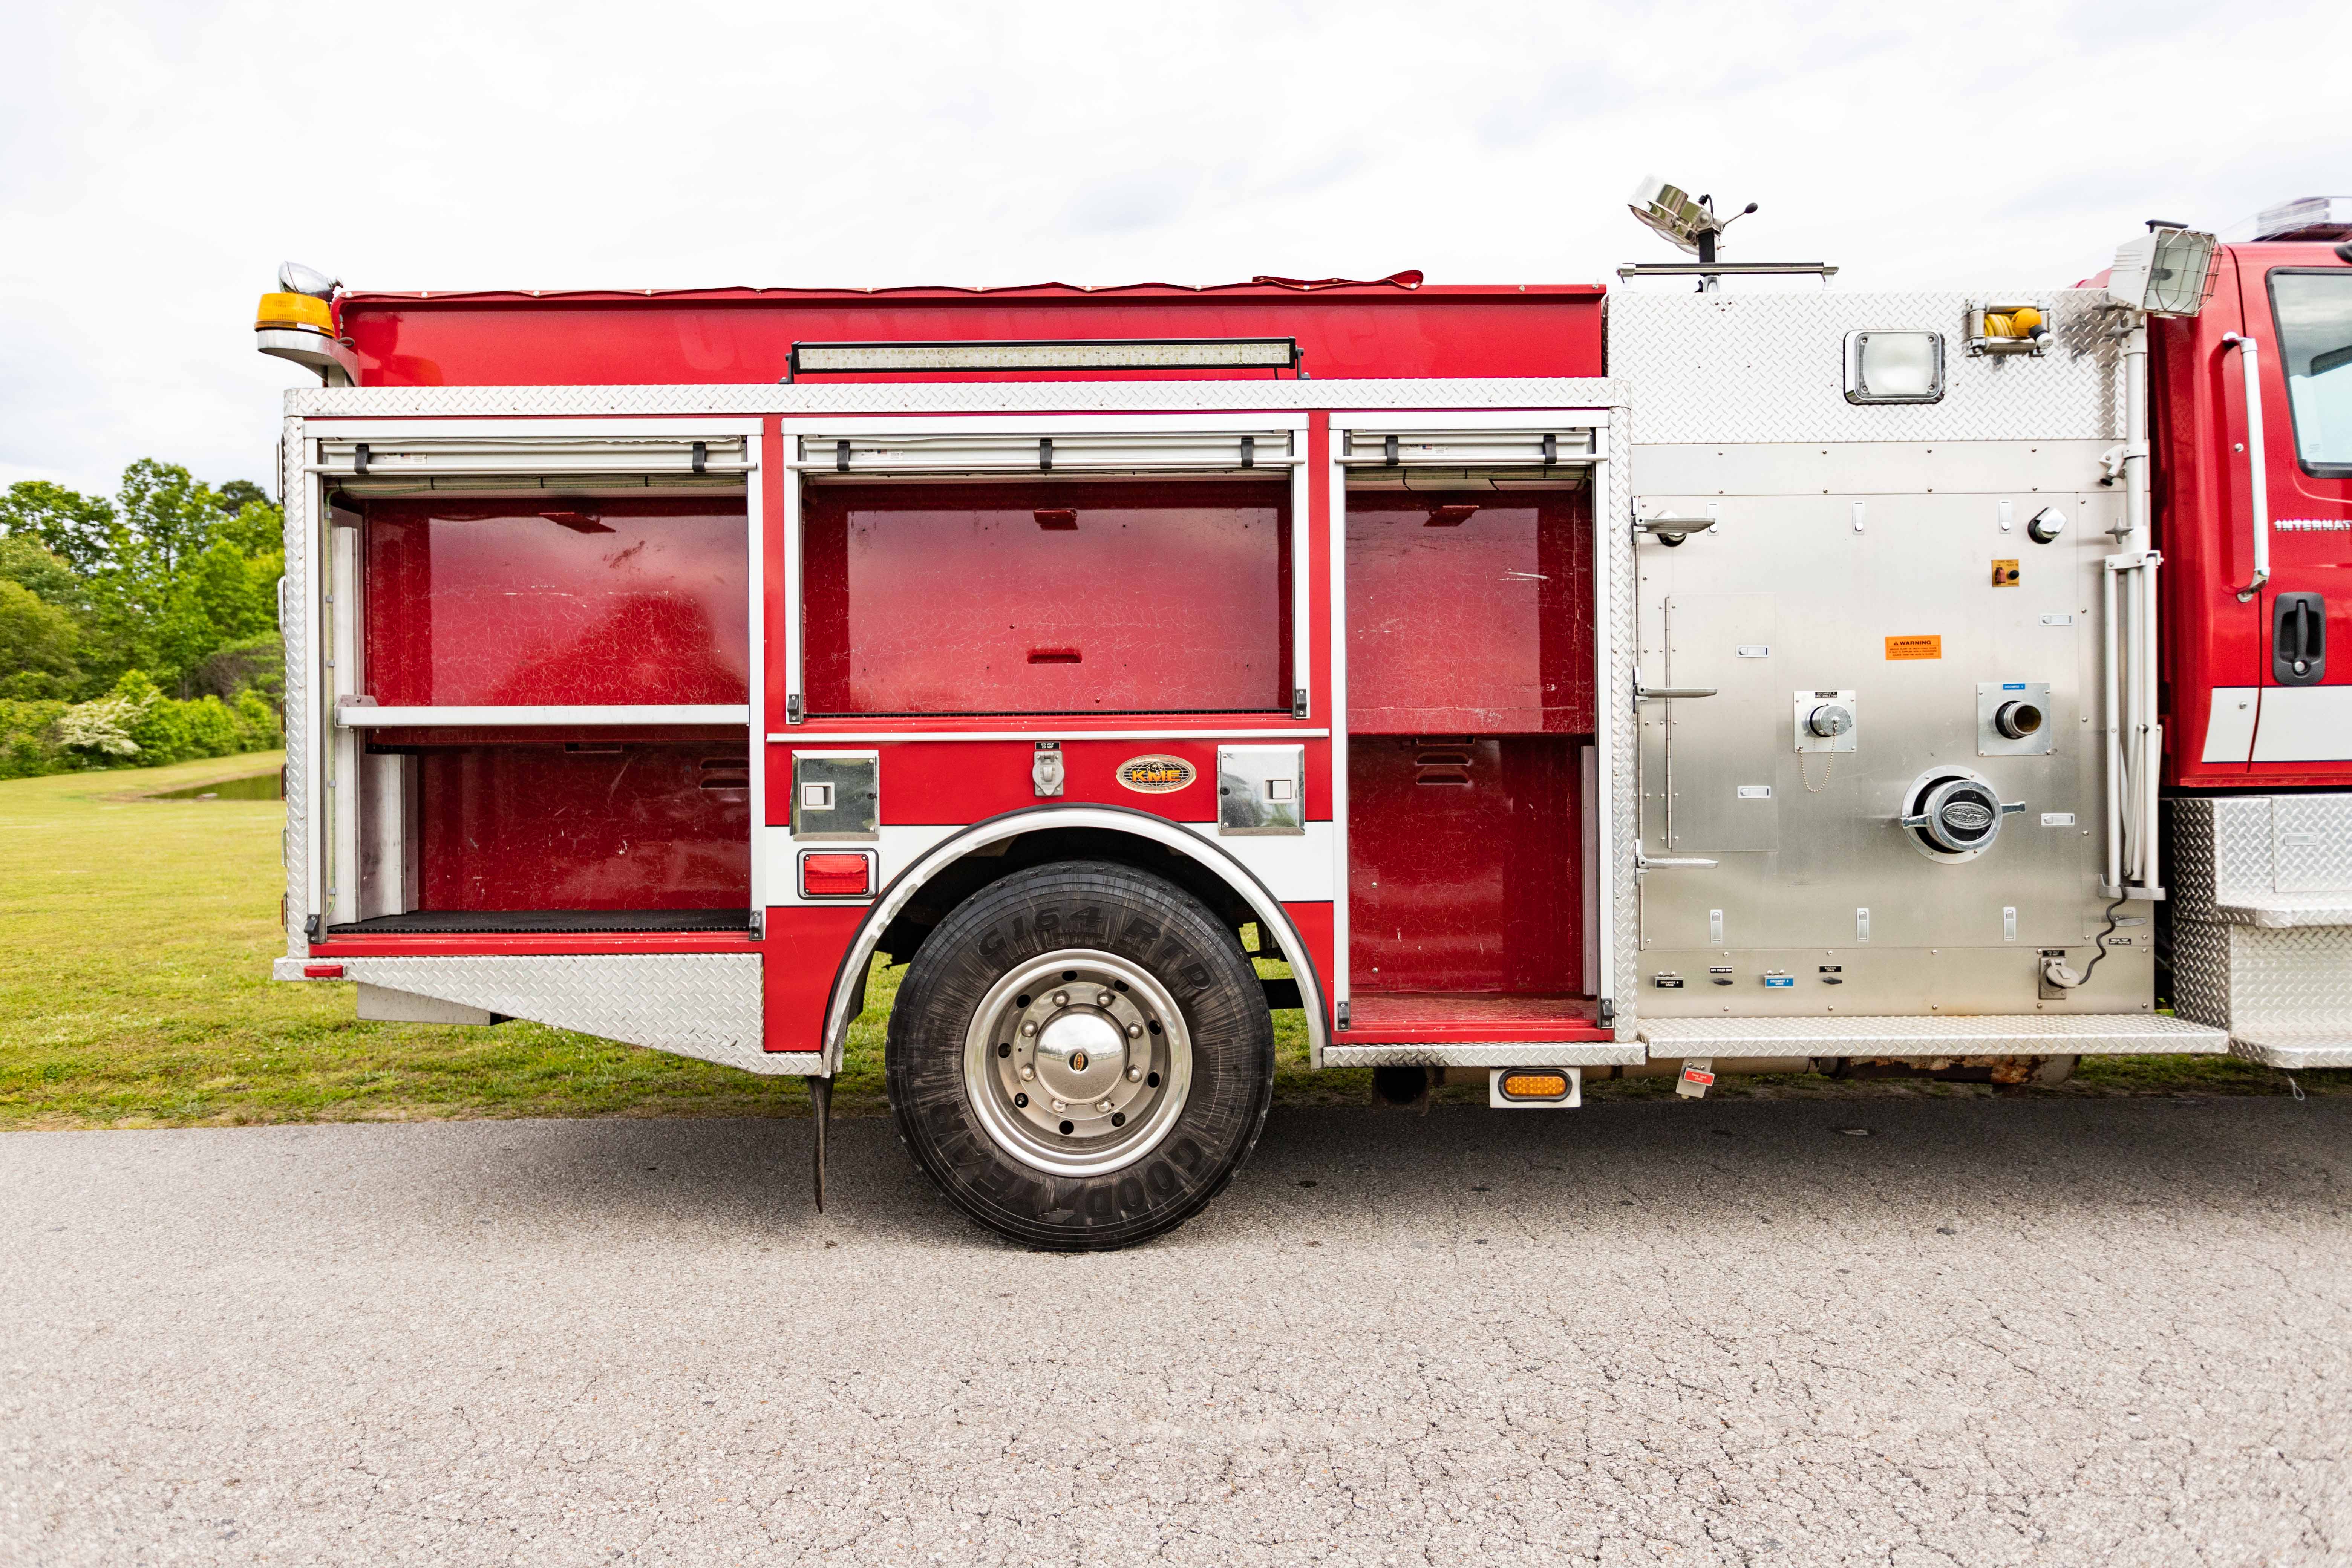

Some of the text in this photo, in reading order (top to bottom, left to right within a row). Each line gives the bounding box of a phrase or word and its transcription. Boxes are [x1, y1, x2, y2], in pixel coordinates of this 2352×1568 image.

[1132, 770, 1181, 782] KME
[977, 906, 1211, 990] G164 RTD
[929, 1098, 1202, 1220] GOODYEAR
